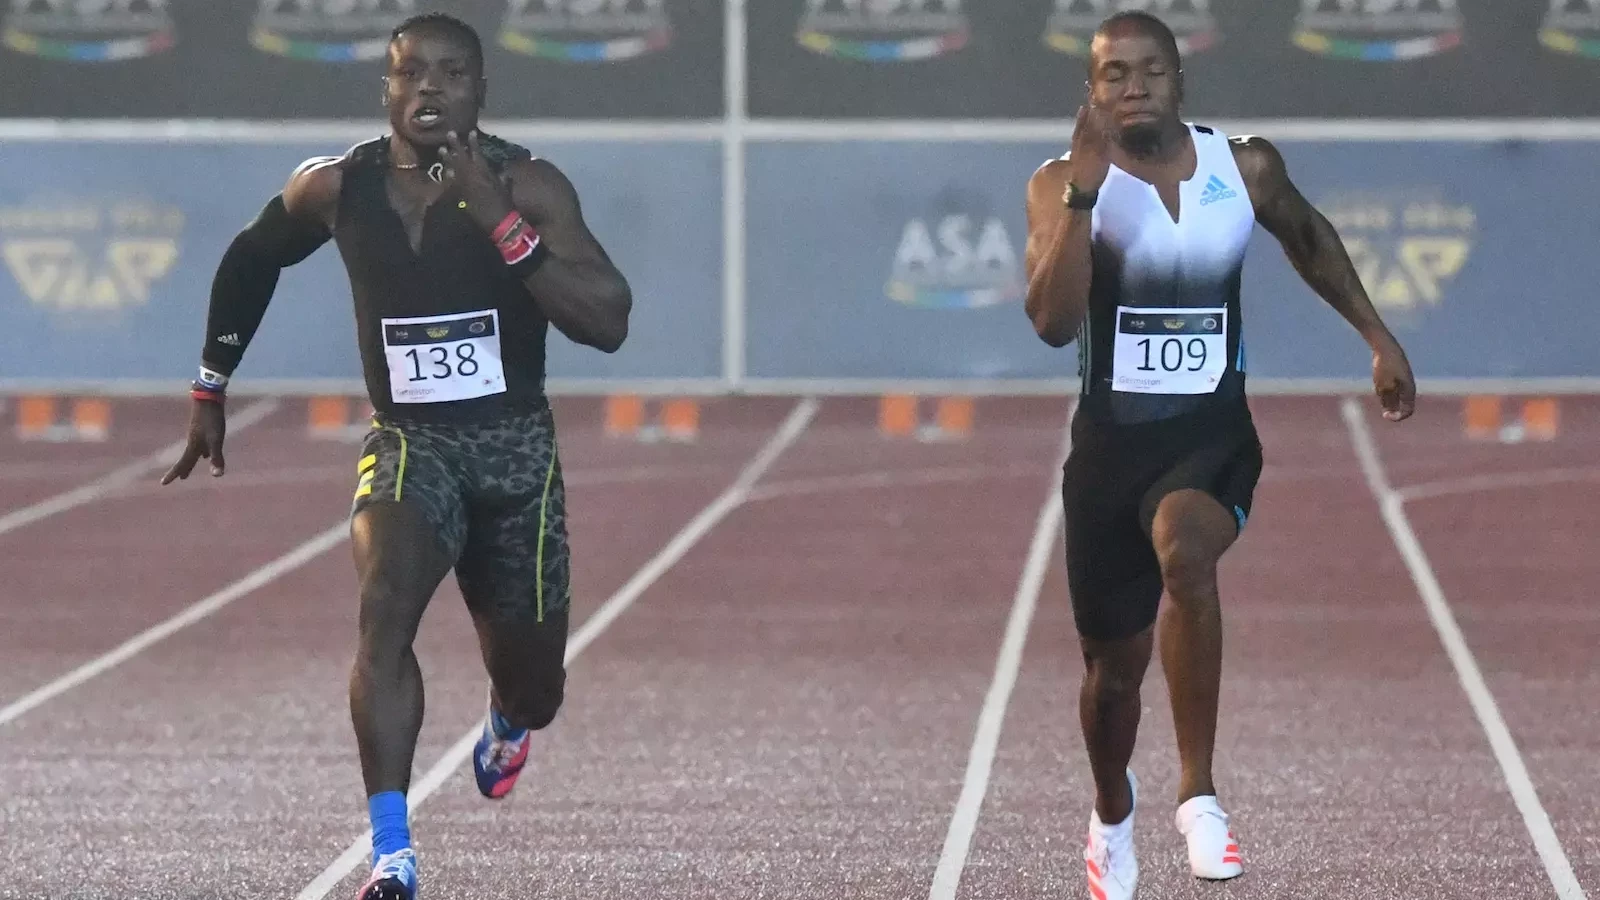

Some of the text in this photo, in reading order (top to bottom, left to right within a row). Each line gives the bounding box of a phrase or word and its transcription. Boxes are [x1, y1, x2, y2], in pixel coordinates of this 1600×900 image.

[1200, 189, 1238, 207] adidas
[895, 213, 1016, 271] ASA
[405, 342, 479, 382] 138
[1136, 338, 1208, 372] 109
